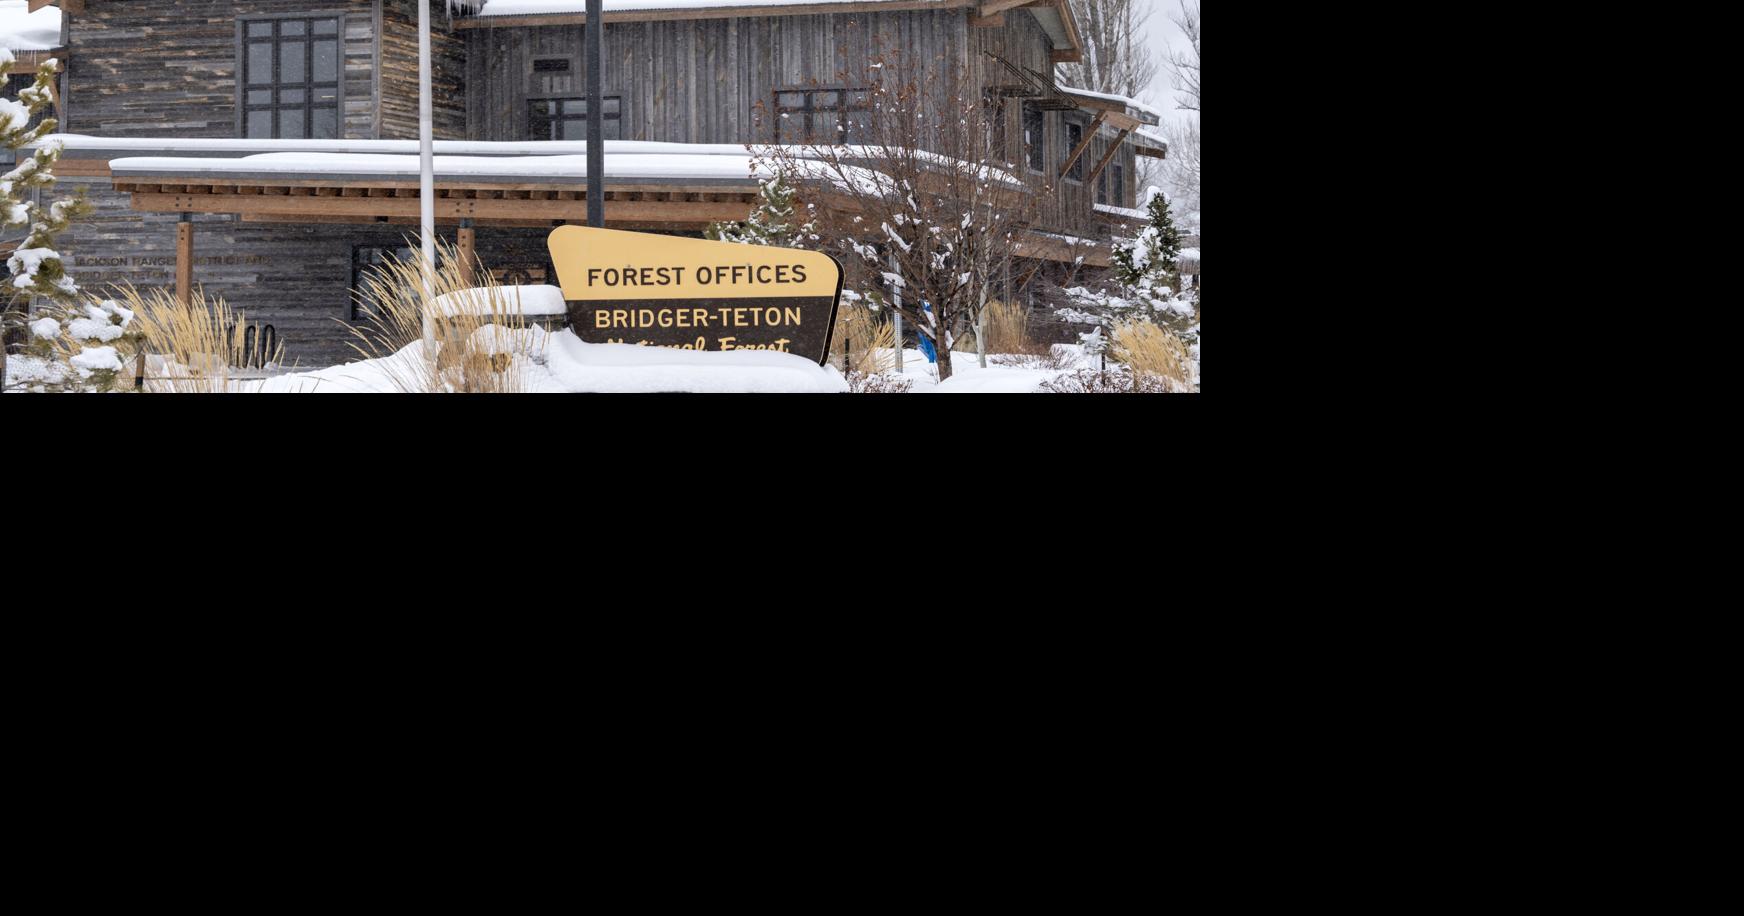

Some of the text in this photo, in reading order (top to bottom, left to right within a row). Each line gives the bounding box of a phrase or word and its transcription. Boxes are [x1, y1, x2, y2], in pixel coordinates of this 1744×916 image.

[588, 264, 807, 287] FOREST OFFICES
[595, 307, 801, 329] BRIDGER-TETON
